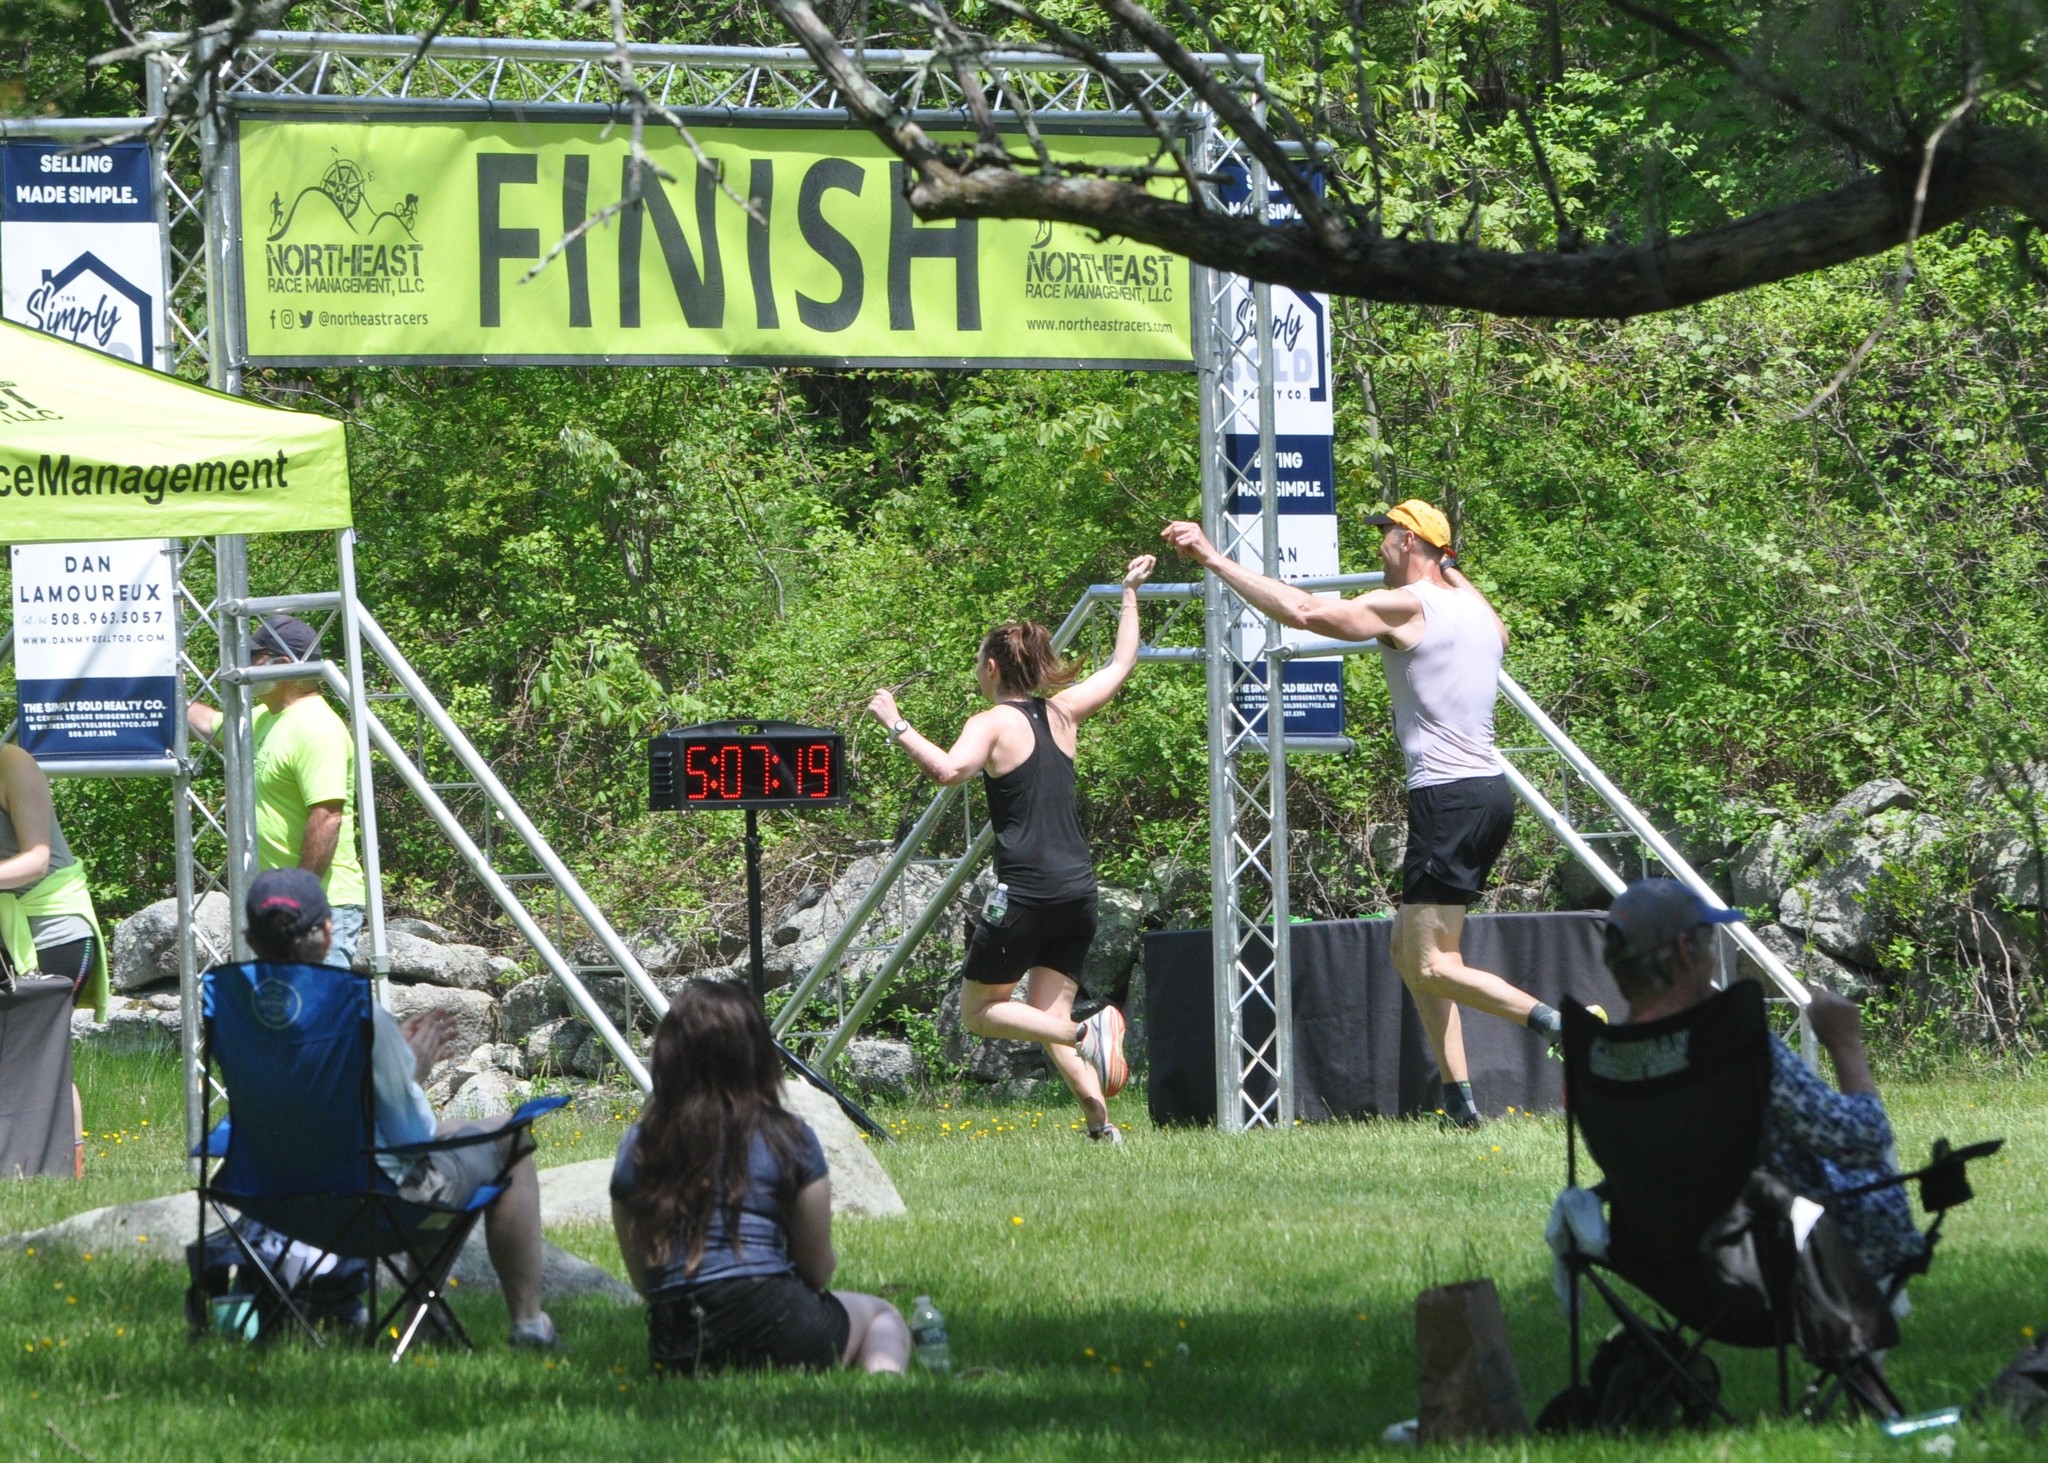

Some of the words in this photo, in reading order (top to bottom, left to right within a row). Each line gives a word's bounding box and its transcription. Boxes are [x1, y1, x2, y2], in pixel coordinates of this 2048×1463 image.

[40, 155, 113, 173] SELLING
[16, 186, 66, 203] MADE
[69, 186, 138, 204] SIMPLE.
[477, 153, 982, 333] FINISH
[266, 244, 423, 277] NORTHEAST
[1026, 251, 1173, 286] NORTHEAST
[268, 278, 303, 294] RACE
[306, 278, 396, 297] MANAGEMENT,
[398, 278, 424, 293] LLC
[1026, 283, 1061, 299] RACE
[1064, 285, 1146, 305] MANAGEMENT,
[1148, 287, 1172, 303] LLC
[26, 284, 122, 347] Simply
[318, 311, 429, 327] @northeastracers
[1026, 317, 1172, 333] www.northeastracers.com
[65, 555, 111, 573] DAN
[20, 583, 161, 603] LAMOUREUX
[51, 611, 162, 626] 508.963.5057
[22, 634, 165, 645] WWW.DANMYREALTOR.COM
[1297, 683, 1324, 693] REALTY
[1324, 683, 1339, 693] CO.
[23, 703, 44, 713] THE
[44, 702, 76, 713] SIMPLY
[76, 701, 103, 712] SOLD
[103, 701, 142, 711] REALTY
[143, 699, 166, 710] CO.
[150, 711, 163, 719] MA
[687, 745, 830, 799] 5:07:19
